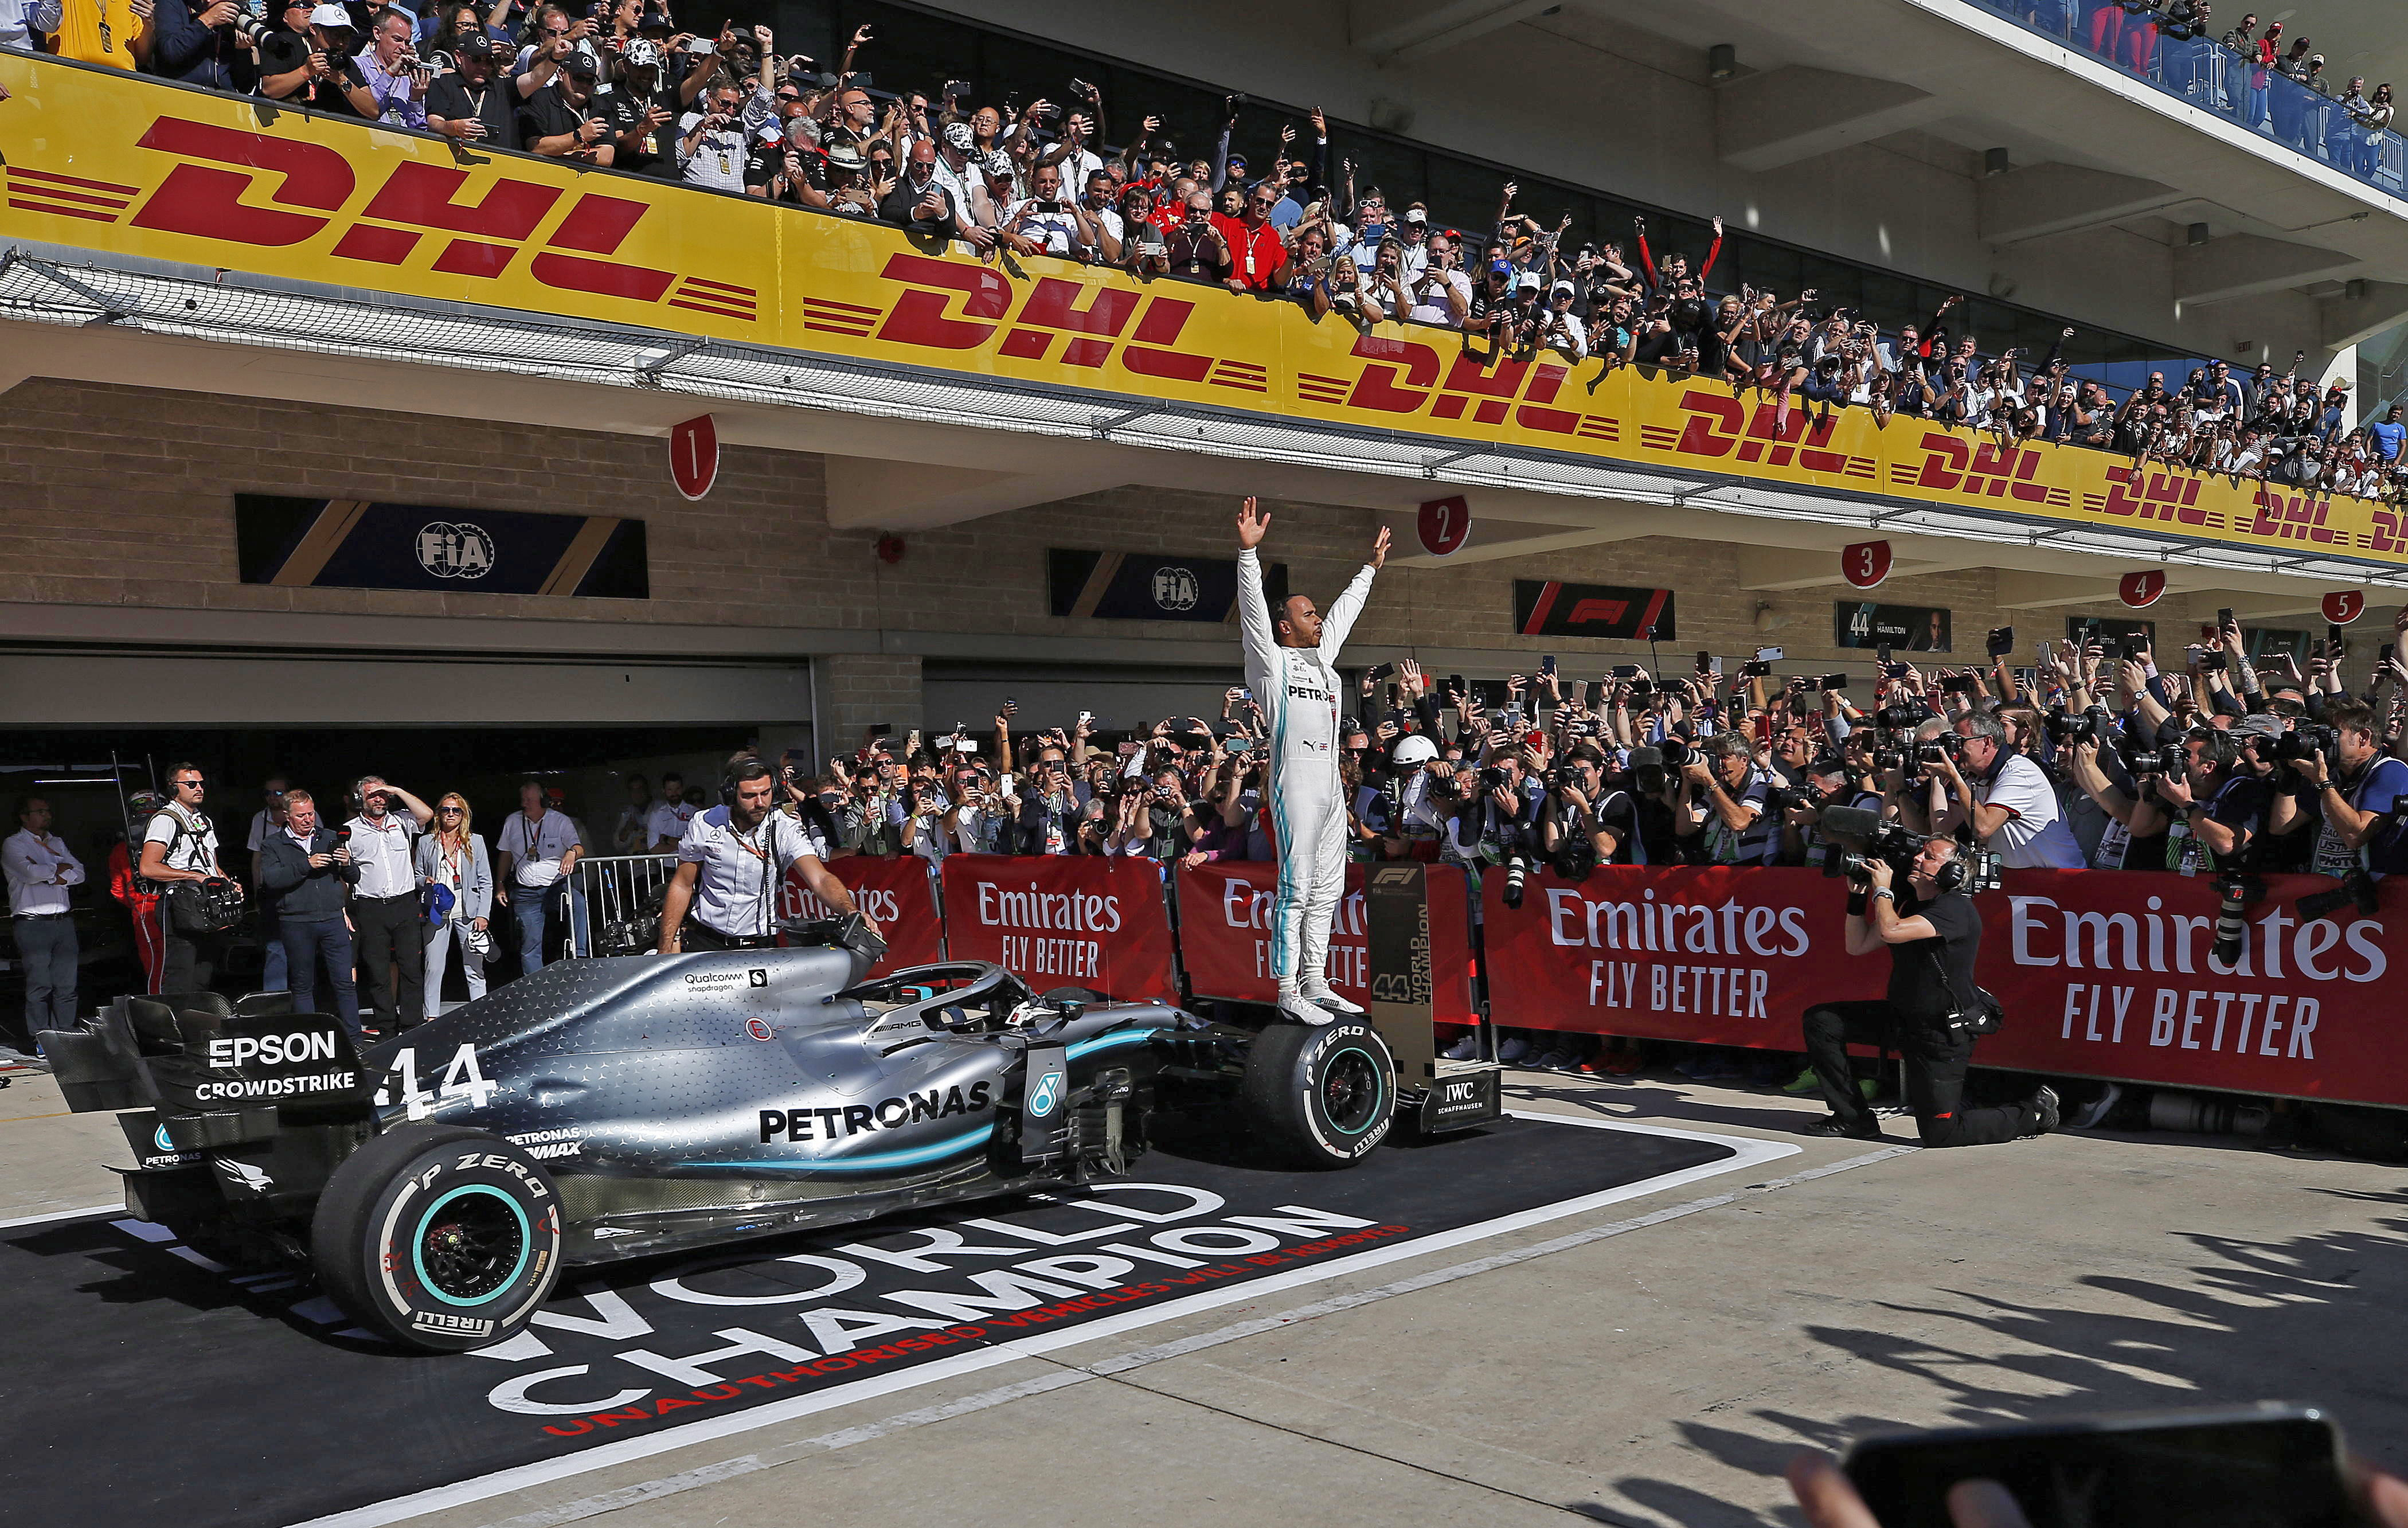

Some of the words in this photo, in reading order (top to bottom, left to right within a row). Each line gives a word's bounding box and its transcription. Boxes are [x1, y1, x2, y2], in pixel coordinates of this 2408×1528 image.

[131, 117, 676, 302] DHL
[877, 253, 1214, 381] DHL
[1348, 335, 1581, 433] DHL
[687, 428, 698, 479] 1
[1677, 392, 1847, 472] DHL
[1918, 433, 2047, 502] DHL
[2105, 466, 2206, 525] DHL
[2251, 491, 2334, 542] DHL
[1437, 505, 1451, 542] 2
[1860, 547, 1873, 577] 3
[2135, 575, 2147, 598] 4
[2338, 595, 2350, 616] 5
[1850, 612, 1869, 636] 44
[1877, 626, 1906, 635] HAMILTON
[2319, 855, 2360, 867] PHOT
[977, 881, 1121, 933] Emirates
[1545, 888, 1809, 957] Emirates
[1003, 935, 1029, 972] FLY
[1036, 937, 1099, 978] BETTER
[1410, 937, 1422, 1005] WORLD
[1418, 904, 1432, 1005] CHAMPION
[684, 972, 744, 985] Qualcomm
[687, 984, 733, 994] snapdragon
[1373, 974, 1410, 1001] 44
[1589, 960, 1637, 1009] FLY
[1651, 963, 1769, 1019] BETTER
[1319, 997, 1340, 1008] PUMA
[2062, 983, 2135, 1044] FLY
[2149, 988, 2321, 1060] BETTER
[209, 1030, 335, 1069] EPSON
[1315, 1026, 1365, 1061] ZERO
[195, 1072, 355, 1101] CROWDSTRIKE
[1437, 1101, 1483, 1115] SCHAFFHAUSEN
[1445, 1081, 1474, 1103] IWC
[759, 1080, 992, 1144] PETRONAS
[455, 1152, 549, 1199] ZERO
[464, 1183, 1225, 1362] WORLD
[411, 1310, 495, 1338] PIRELLI
[488, 1205, 1379, 1416] CHAMPION
[542, 1326, 988, 1437] UNAUTHORISED
[991, 1283, 1171, 1331] VEHICLES
[1162, 1262, 1253, 1285] WILL
[1245, 1251, 1284, 1267] BE
[1282, 1224, 1410, 1258] REMOVED
